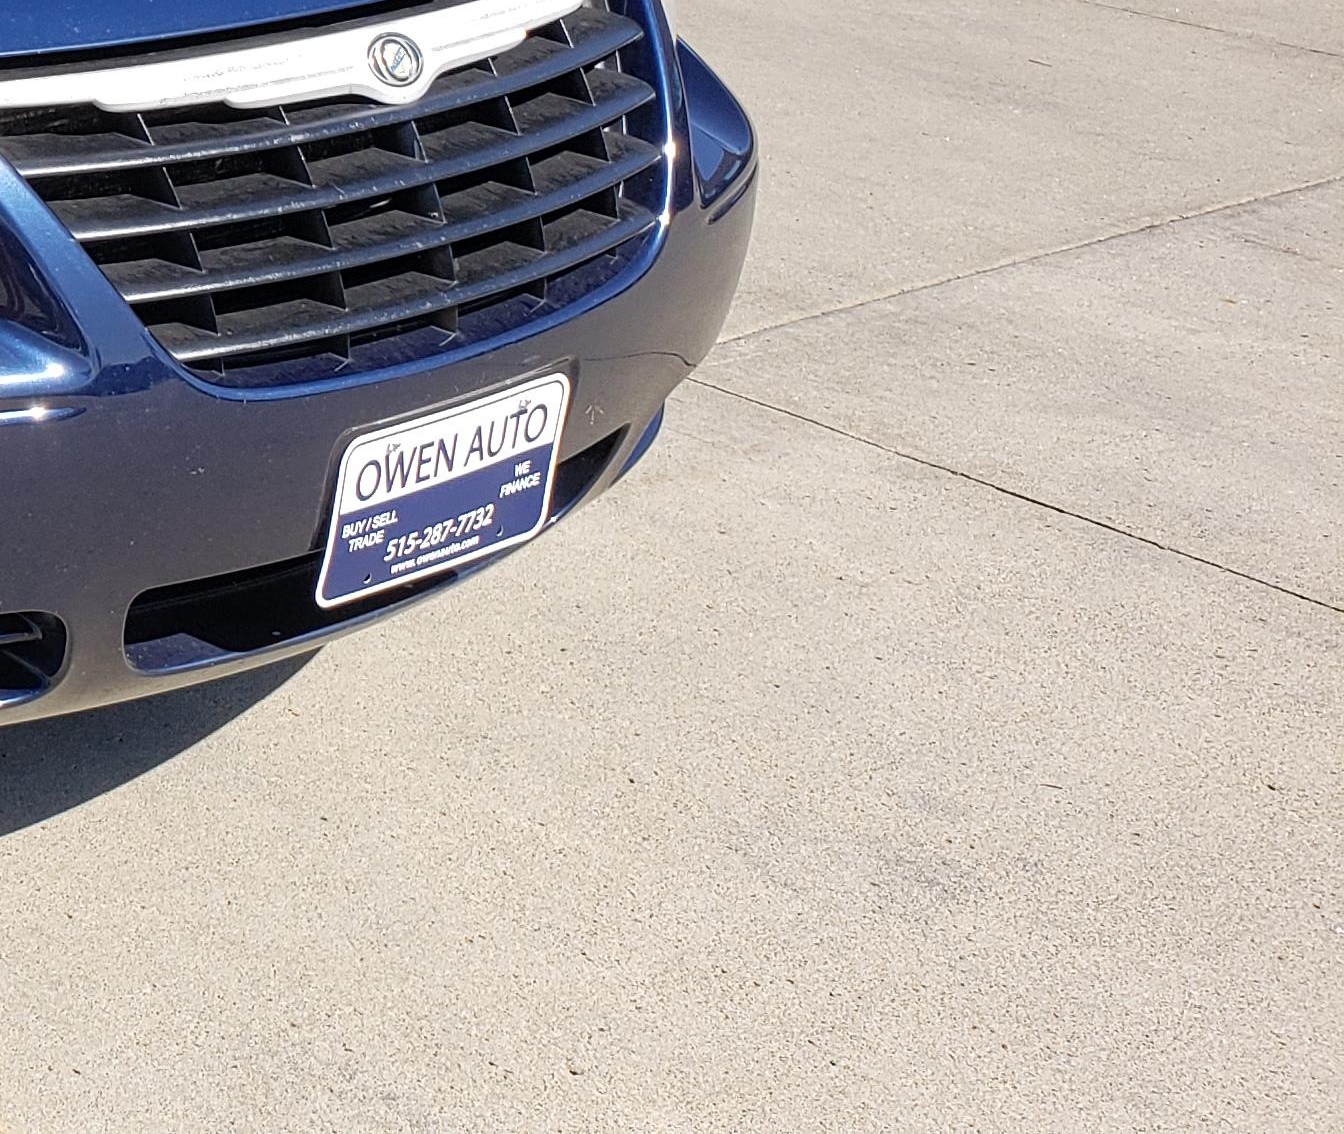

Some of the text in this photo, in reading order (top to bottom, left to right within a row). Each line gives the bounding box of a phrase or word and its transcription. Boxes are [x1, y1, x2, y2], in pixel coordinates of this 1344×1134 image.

[355, 403, 548, 501] OWEN AUTO
[514, 460, 531, 477] WE
[499, 471, 541, 499] FINANCE
[348, 529, 385, 553] TRADE
[384, 503, 494, 562] 515-287-7732
